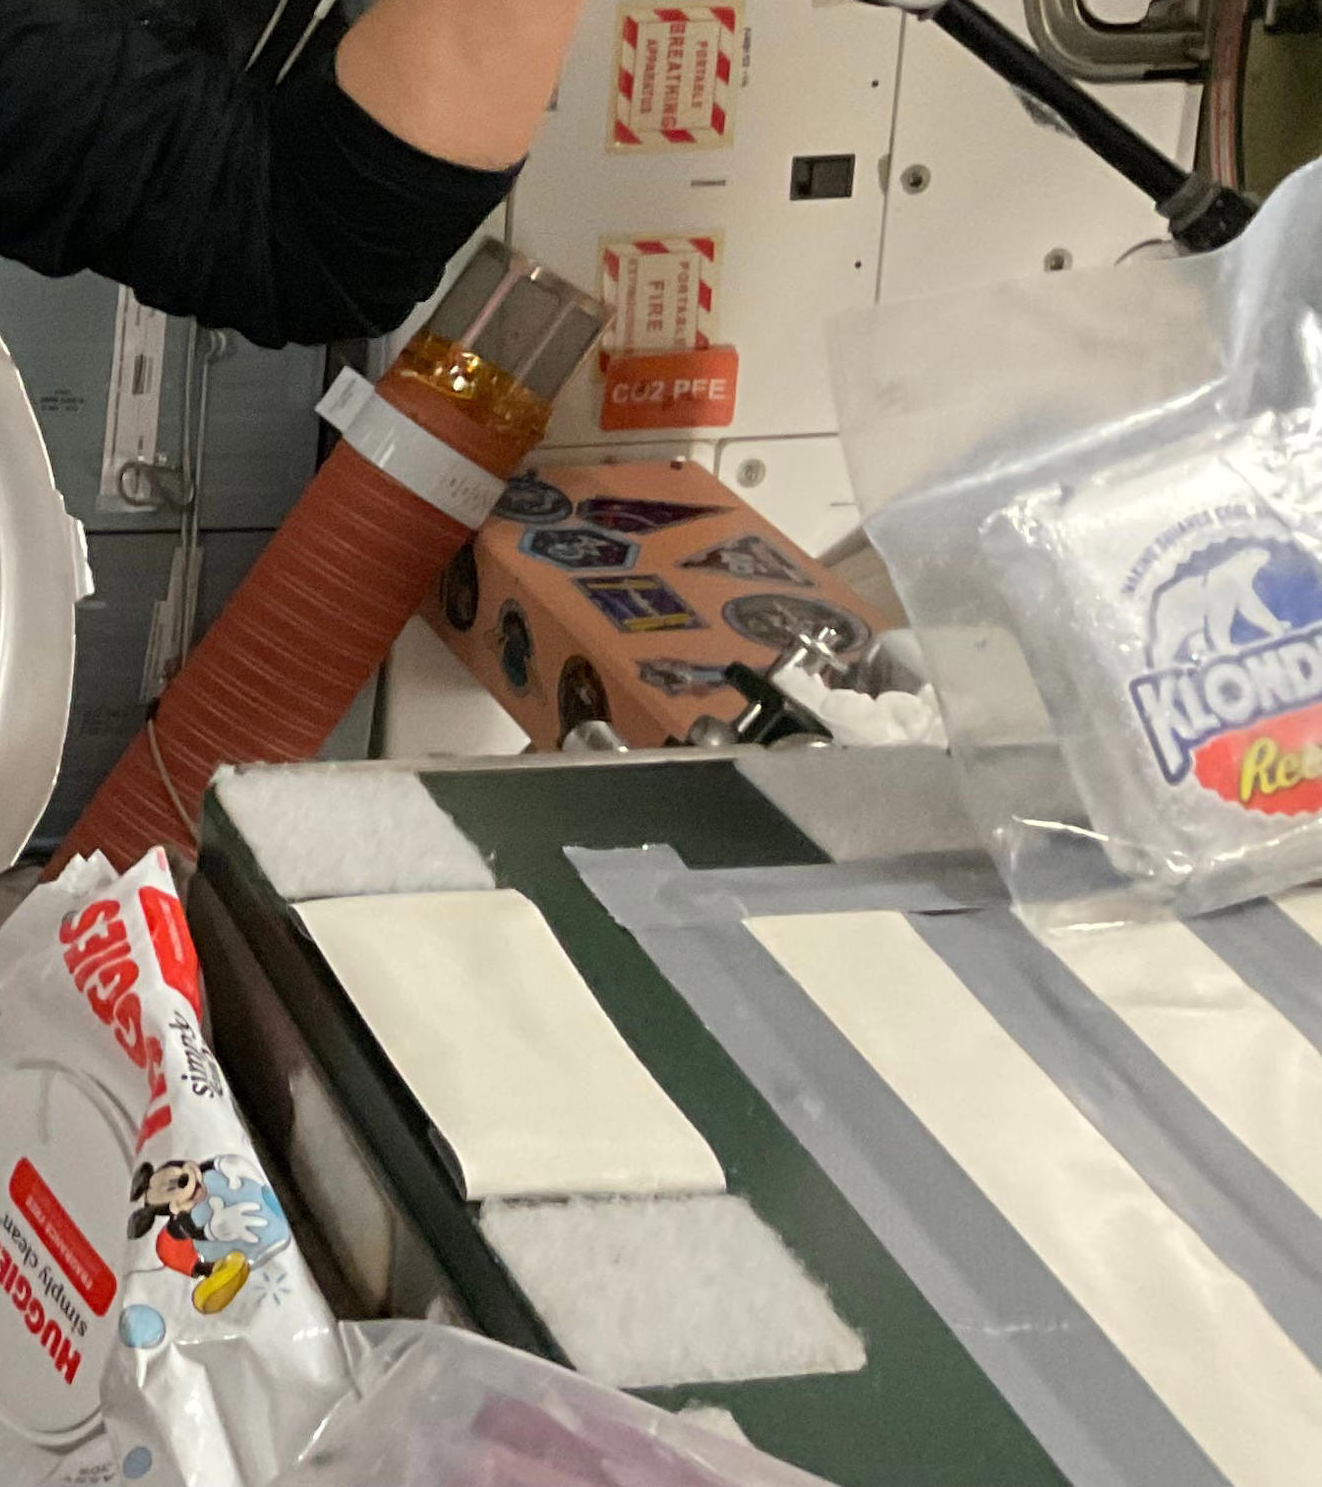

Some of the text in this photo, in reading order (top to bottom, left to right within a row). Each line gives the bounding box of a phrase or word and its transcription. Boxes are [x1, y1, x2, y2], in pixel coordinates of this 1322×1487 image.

[641, 39, 658, 114] APPARATUS
[660, 20, 686, 130] BREATHING
[691, 41, 709, 108] PORTABLE
[646, 280, 665, 331] FIRE
[674, 260, 690, 346] PORTABLE
[611, 377, 728, 404] CO2 PFE
[1133, 633, 1322, 779] KLOND
[1, 1213, 89, 1338] simply clean
